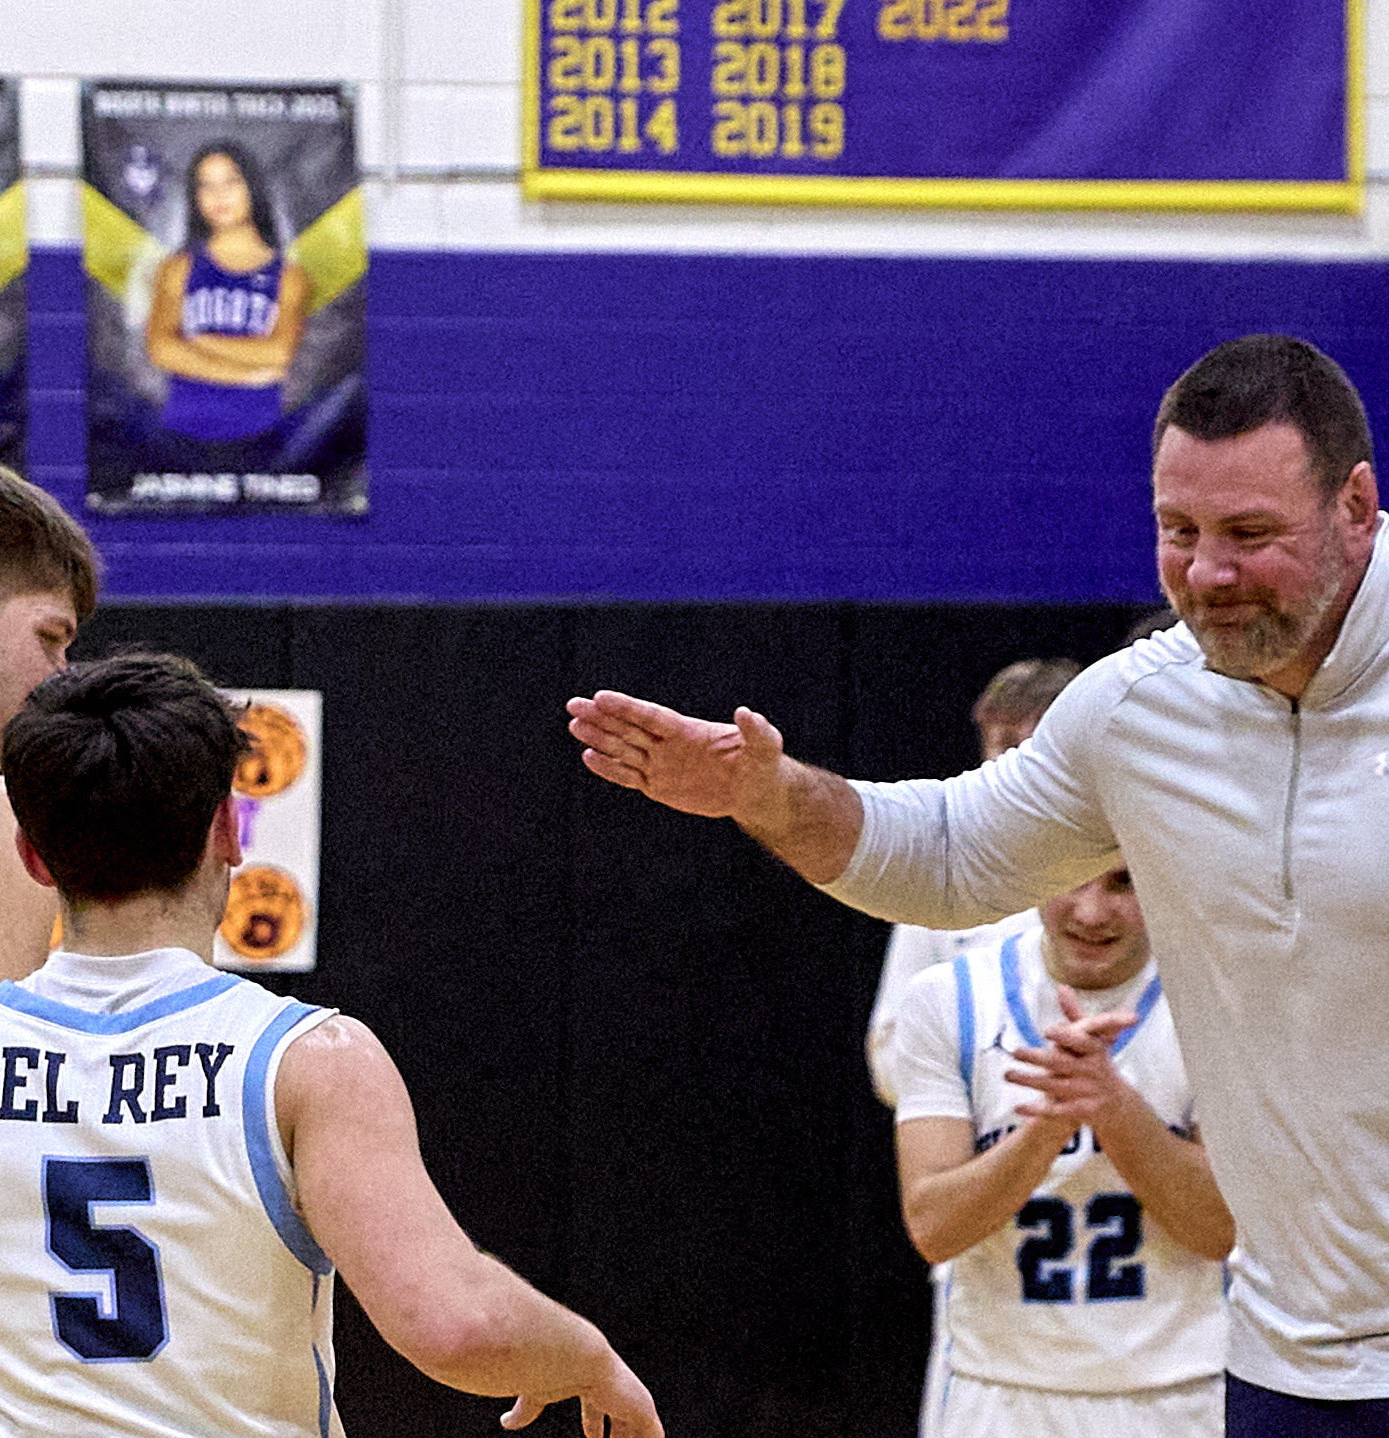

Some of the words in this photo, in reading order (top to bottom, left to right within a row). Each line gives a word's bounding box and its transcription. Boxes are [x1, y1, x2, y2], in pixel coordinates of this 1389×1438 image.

[548, 0, 681, 33] 2012
[712, 0, 844, 40] 2017
[876, 0, 1010, 43] 2022
[547, 35, 681, 95] 2013
[712, 41, 847, 100] 2018
[547, 96, 679, 154] 2014
[712, 101, 847, 160] 2019
[102, 1043, 235, 1126] REY
[41, 1154, 171, 1364] 5
[1015, 1191, 1147, 1304] 22
